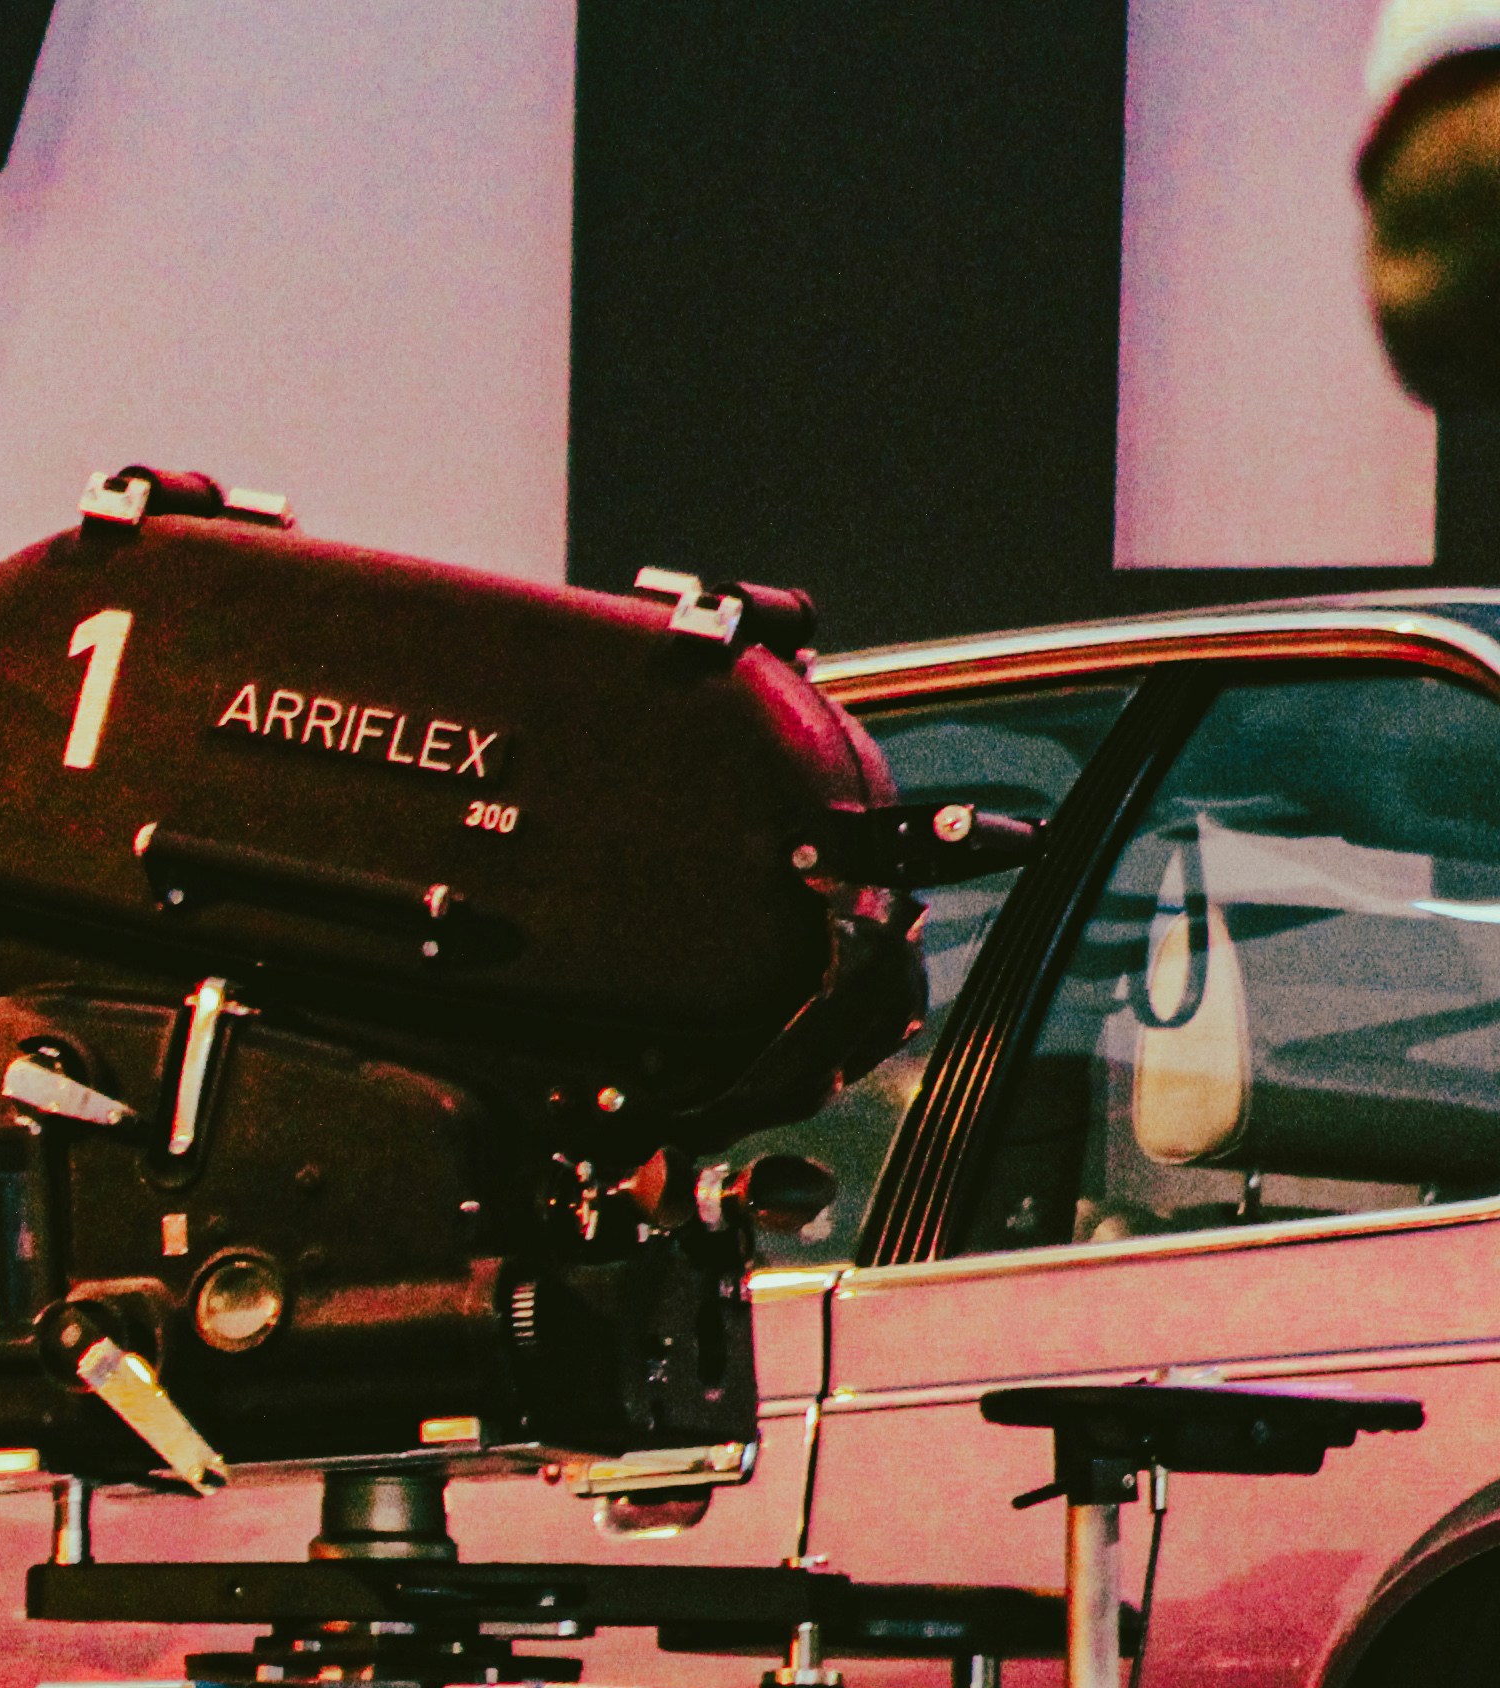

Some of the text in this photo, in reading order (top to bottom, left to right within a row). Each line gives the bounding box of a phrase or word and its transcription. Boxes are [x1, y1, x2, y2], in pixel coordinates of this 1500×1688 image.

[63, 609, 133, 769] 1
[217, 683, 498, 778] ARRIFLEX
[465, 800, 520, 834] 300
